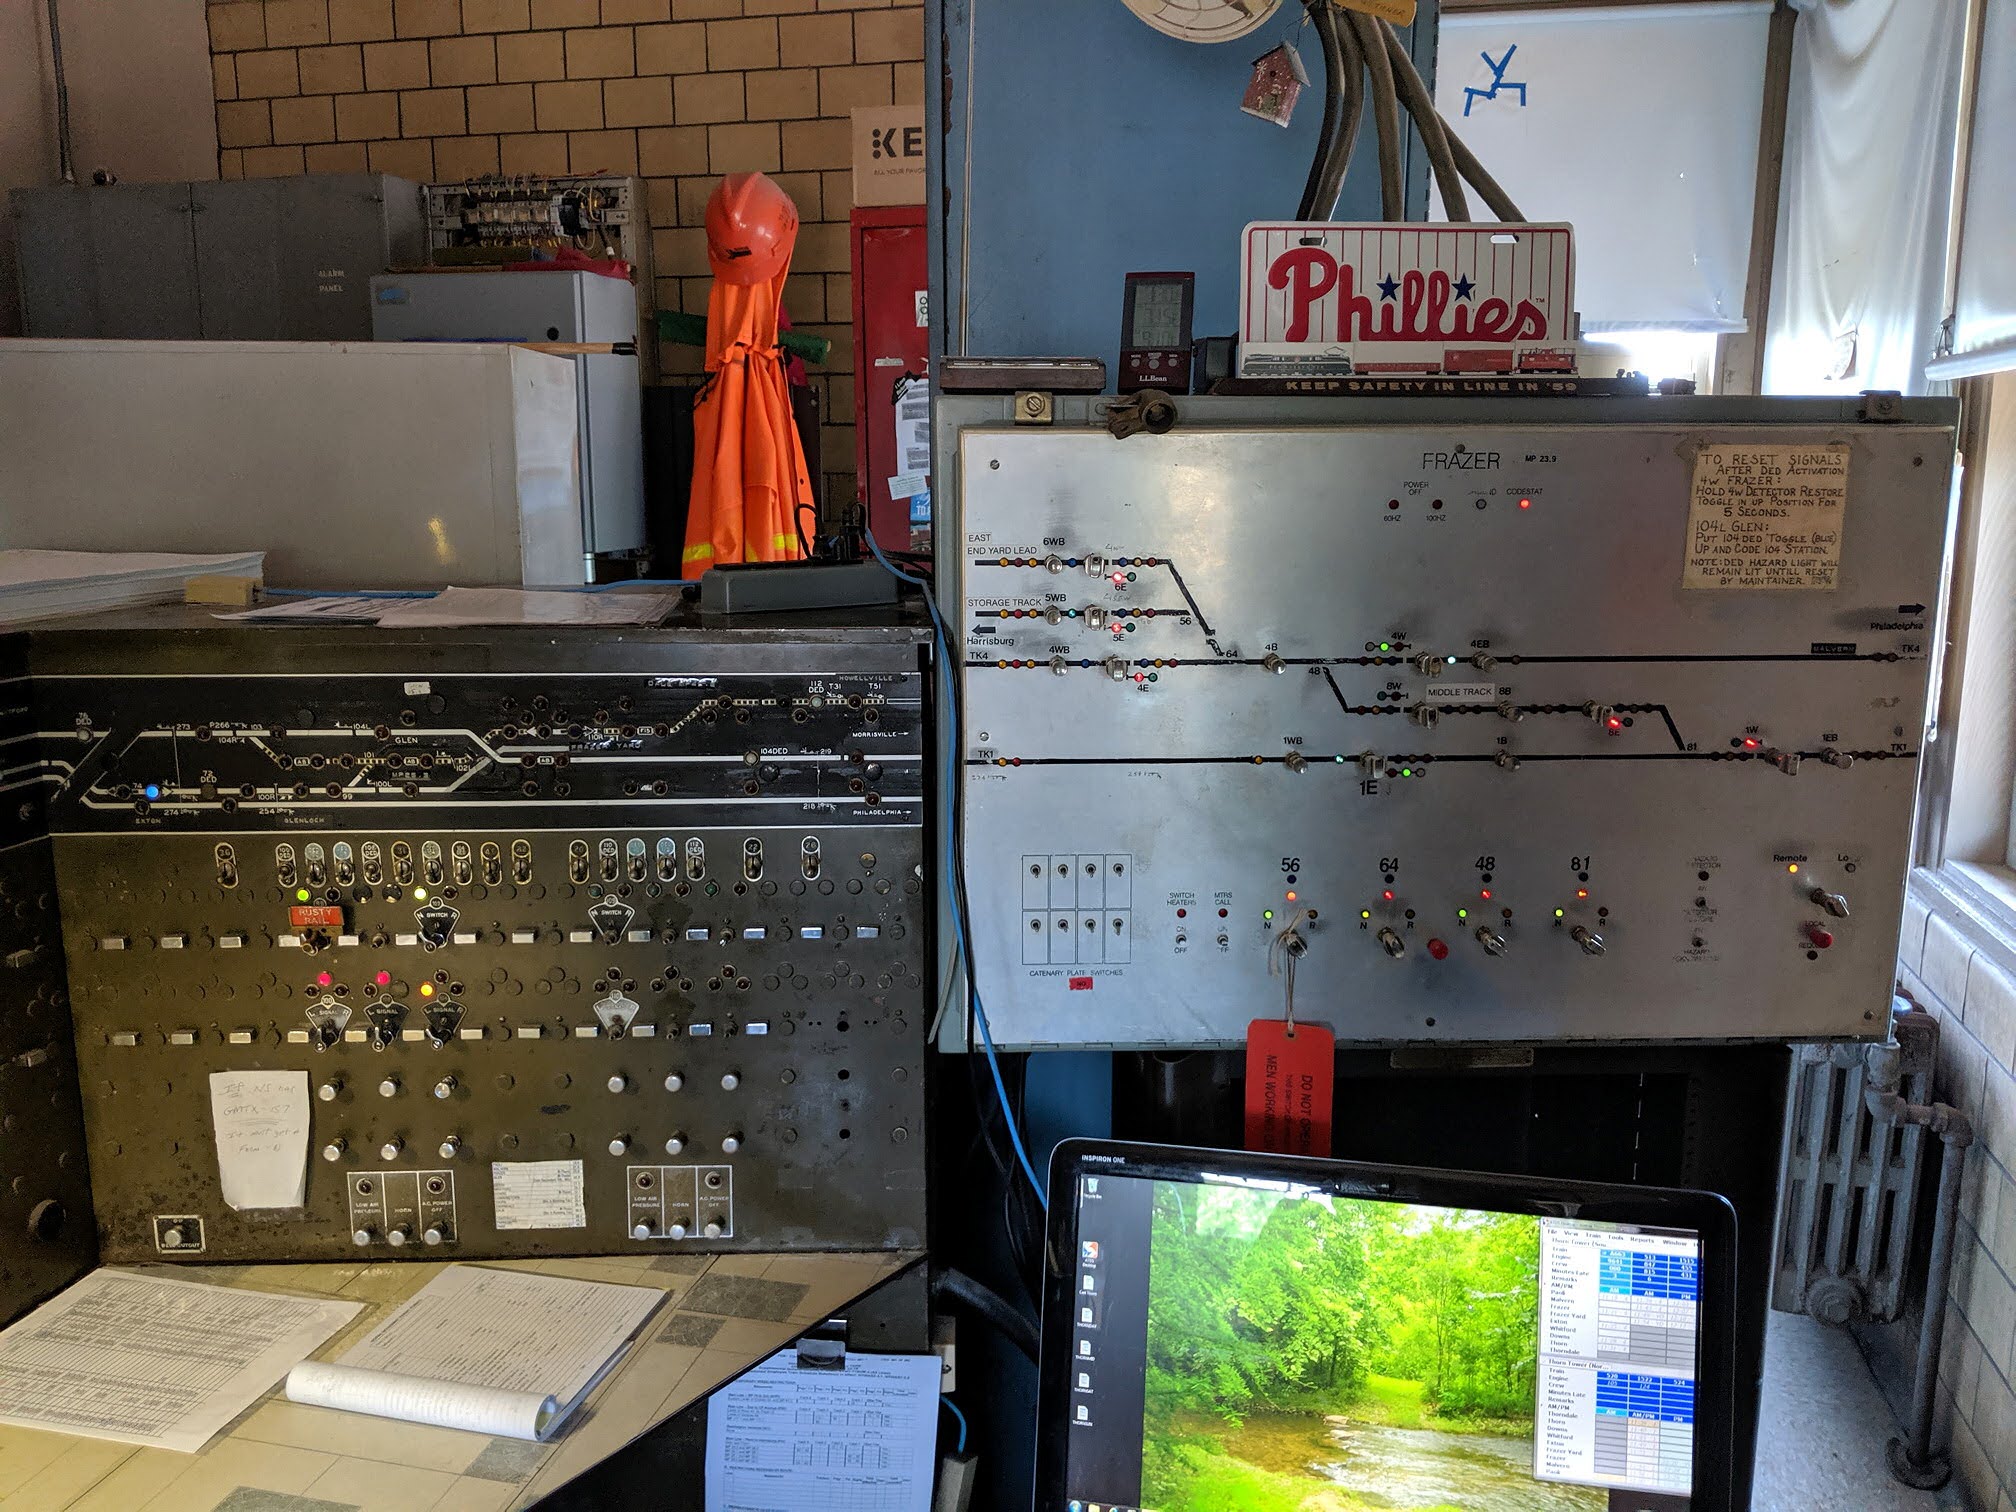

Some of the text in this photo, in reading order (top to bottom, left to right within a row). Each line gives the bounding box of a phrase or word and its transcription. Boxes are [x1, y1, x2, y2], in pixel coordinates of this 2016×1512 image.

[1268, 247, 1547, 342] Phillies
[1287, 381, 1340, 390] KEEP
[1348, 381, 1426, 391] SAFETY
[1434, 381, 1455, 391] IN
[1464, 381, 1510, 391] LINE
[1518, 381, 1539, 391] IN
[1422, 452, 1500, 470] FRAZER
[1701, 454, 1842, 466] TO RESET SIGNALS
[1716, 466, 1844, 475] AFTER DED ACTIVATION
[1696, 486, 1844, 496] HOLD DETECTOR RESTORE
[1696, 496, 1734, 506] TOGGLE
[1770, 496, 1814, 506] POSITION
[1818, 498, 1836, 506] FOR
[1724, 507, 1732, 518] 5
[1696, 520, 1726, 532] 104L
[968, 534, 991, 543] EAST
[1043, 537, 1066, 546] 6WB
[1696, 532, 1718, 544] PUT
[1723, 534, 1739, 543] 104
[1742, 535, 1762, 543] DED
[1766, 533, 1806, 544] TOGGLE
[967, 546, 1037, 555] END YARD LEAD
[1694, 544, 1710, 554] UP
[1713, 546, 1732, 554] AND
[1734, 544, 1760, 554] CODE
[1702, 568, 1740, 576] REMAIN
[1745, 568, 1760, 576] LIT
[1766, 568, 1800, 576] UNTILL
[1115, 583, 1127, 592] 6E
[1044, 594, 1067, 602] 5WB
[968, 598, 1042, 608] STORAGE TRACK
[1180, 616, 1192, 626] 56
[1870, 622, 1924, 632] Philadelphia
[1113, 634, 1125, 642] 5E
[1391, 632, 1407, 640] 4W
[966, 636, 1014, 647] Harrisburg
[1470, 640, 1490, 648] 4EB
[1048, 646, 1070, 654] 4WB
[1264, 643, 1278, 651] 4B
[1902, 644, 1920, 652] TK4
[970, 652, 988, 660] TK4
[1226, 650, 1238, 658] 64
[1308, 667, 1320, 676] 48
[1137, 684, 1150, 693] 4E
[1386, 682, 1402, 690] 8W
[1428, 687, 1492, 696] MIDDLE TRACK
[1498, 687, 1512, 696] 8B
[1284, 736, 1303, 745] 1WB
[1496, 736, 1508, 745] 1B
[1822, 734, 1838, 742] 1EB
[1686, 742, 1698, 750] 81
[978, 750, 994, 758] TK1
[1360, 780, 1378, 796] 1E
[1281, 858, 1301, 872] 56
[1379, 858, 1399, 872] 64
[1474, 856, 1496, 871] 48
[1571, 856, 1590, 870] 81
[299, 908, 332, 916] RUSTY
[304, 916, 330, 924] RAIL
[1266, 1054, 1277, 1079] MEN
[1302, 1074, 1313, 1091] DO
[1302, 1092, 1312, 1116] NOT
